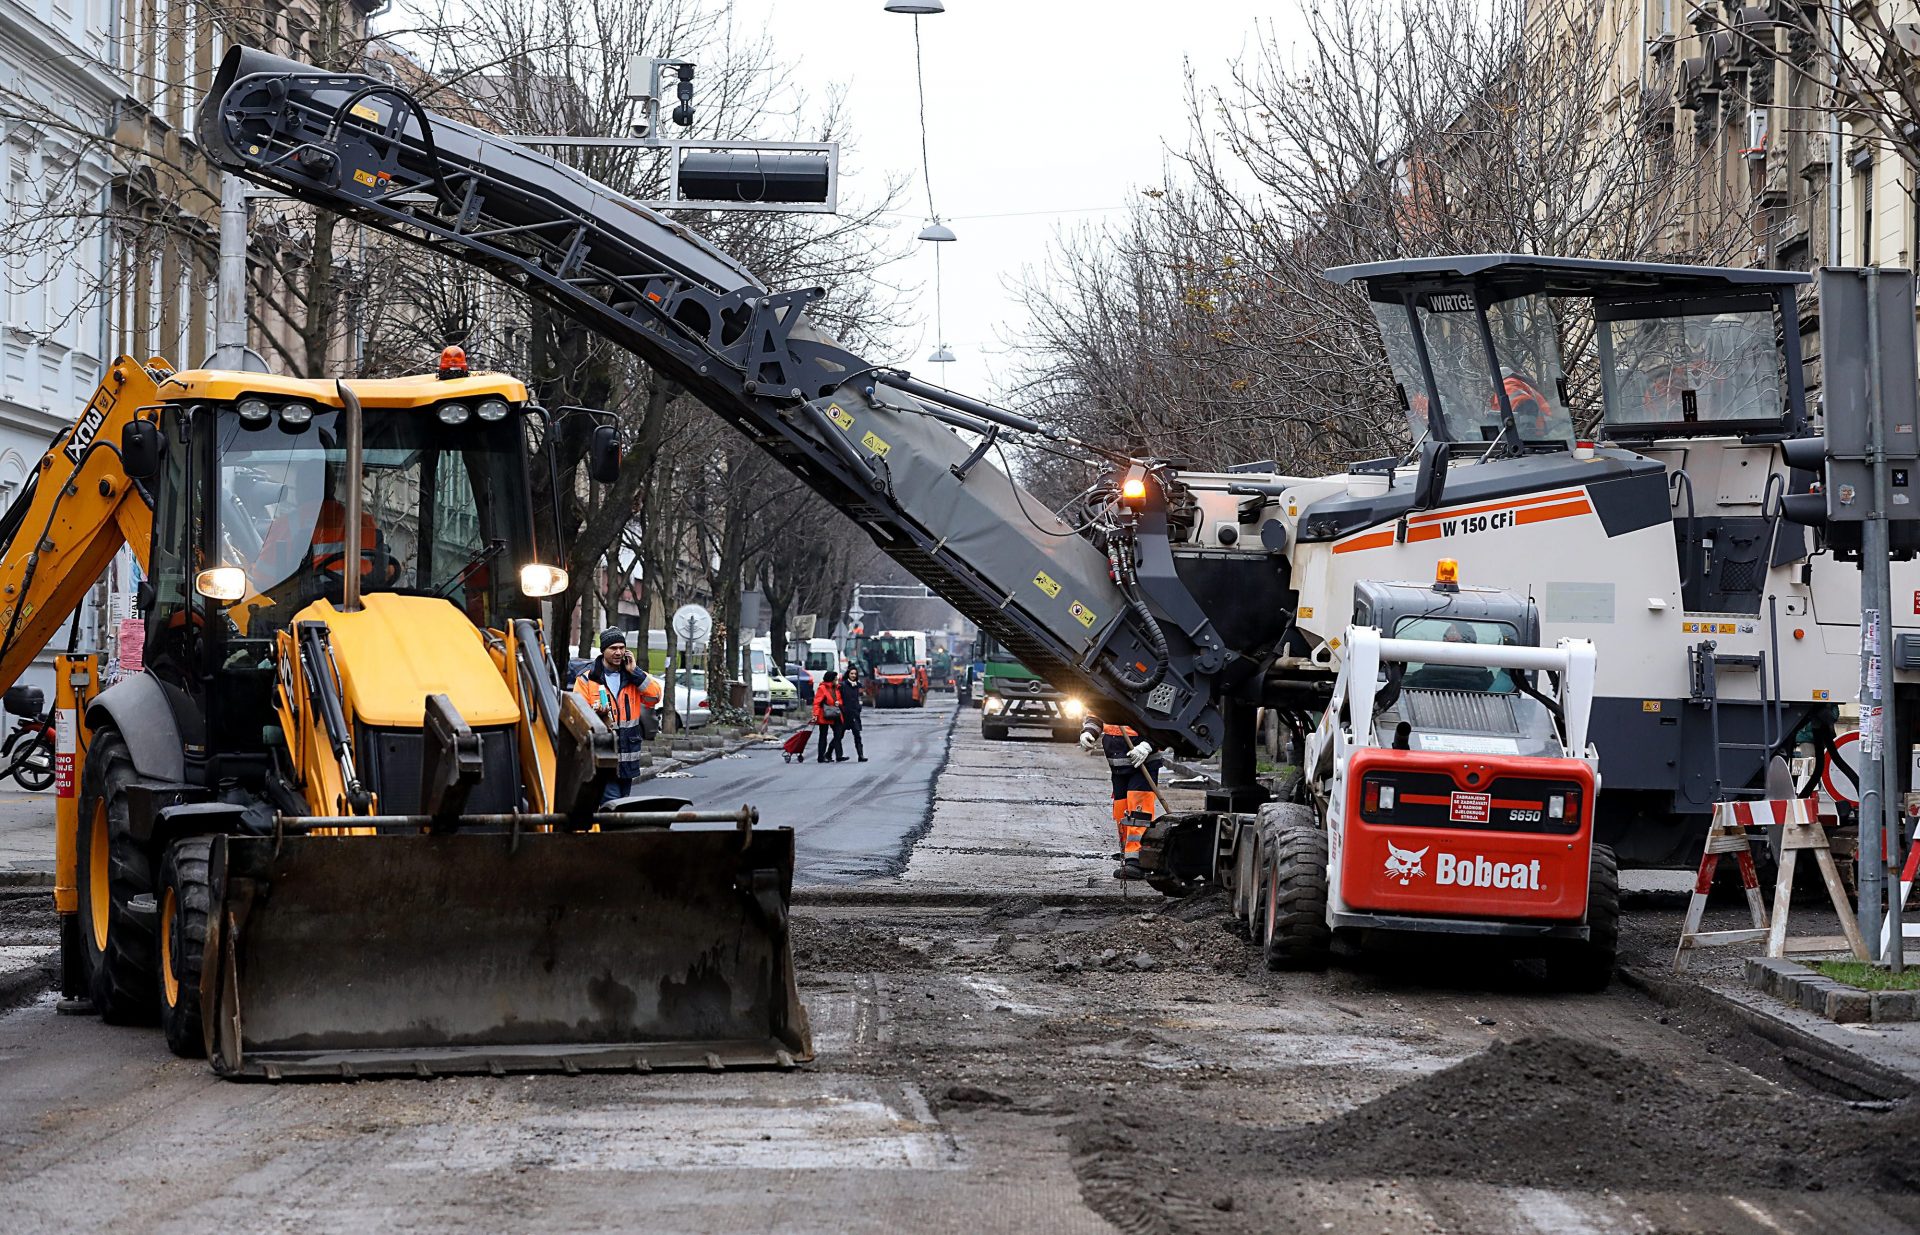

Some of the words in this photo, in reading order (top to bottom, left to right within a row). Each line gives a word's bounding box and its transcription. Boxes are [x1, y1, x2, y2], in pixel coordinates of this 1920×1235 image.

[1430, 294, 1475, 311] WIRTGE
[67, 407, 103, 460] 3CX
[1443, 521, 1457, 537] W
[1461, 516, 1487, 534] 150
[1509, 809, 1541, 822] S650
[1436, 853, 1540, 890] Bobcat
